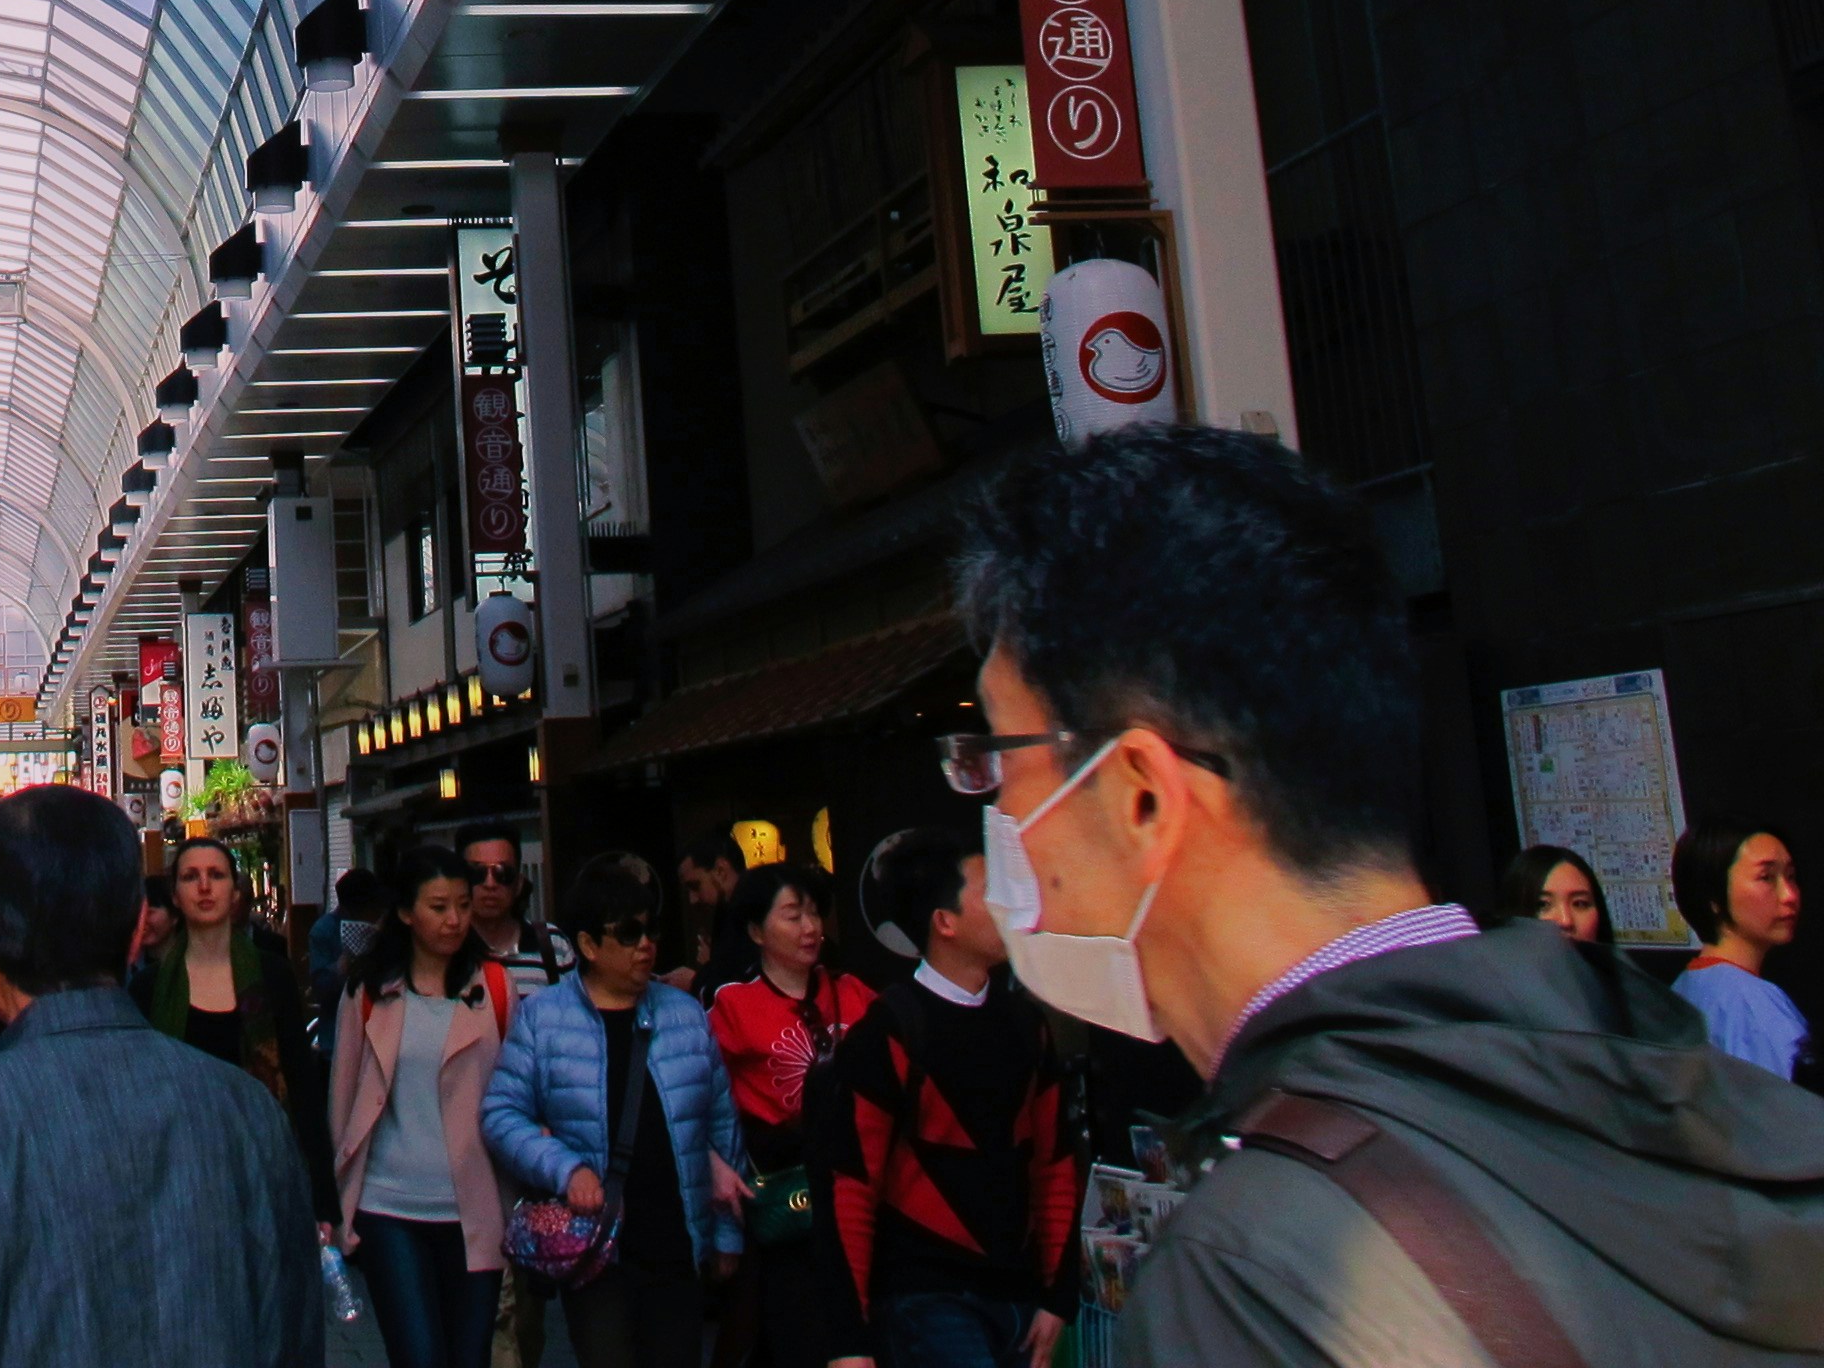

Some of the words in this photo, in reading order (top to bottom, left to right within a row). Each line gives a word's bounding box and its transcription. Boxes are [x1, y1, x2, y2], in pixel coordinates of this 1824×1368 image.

[981, 153, 1040, 315] 和泉屋
[473, 389, 517, 539] 観音通り
